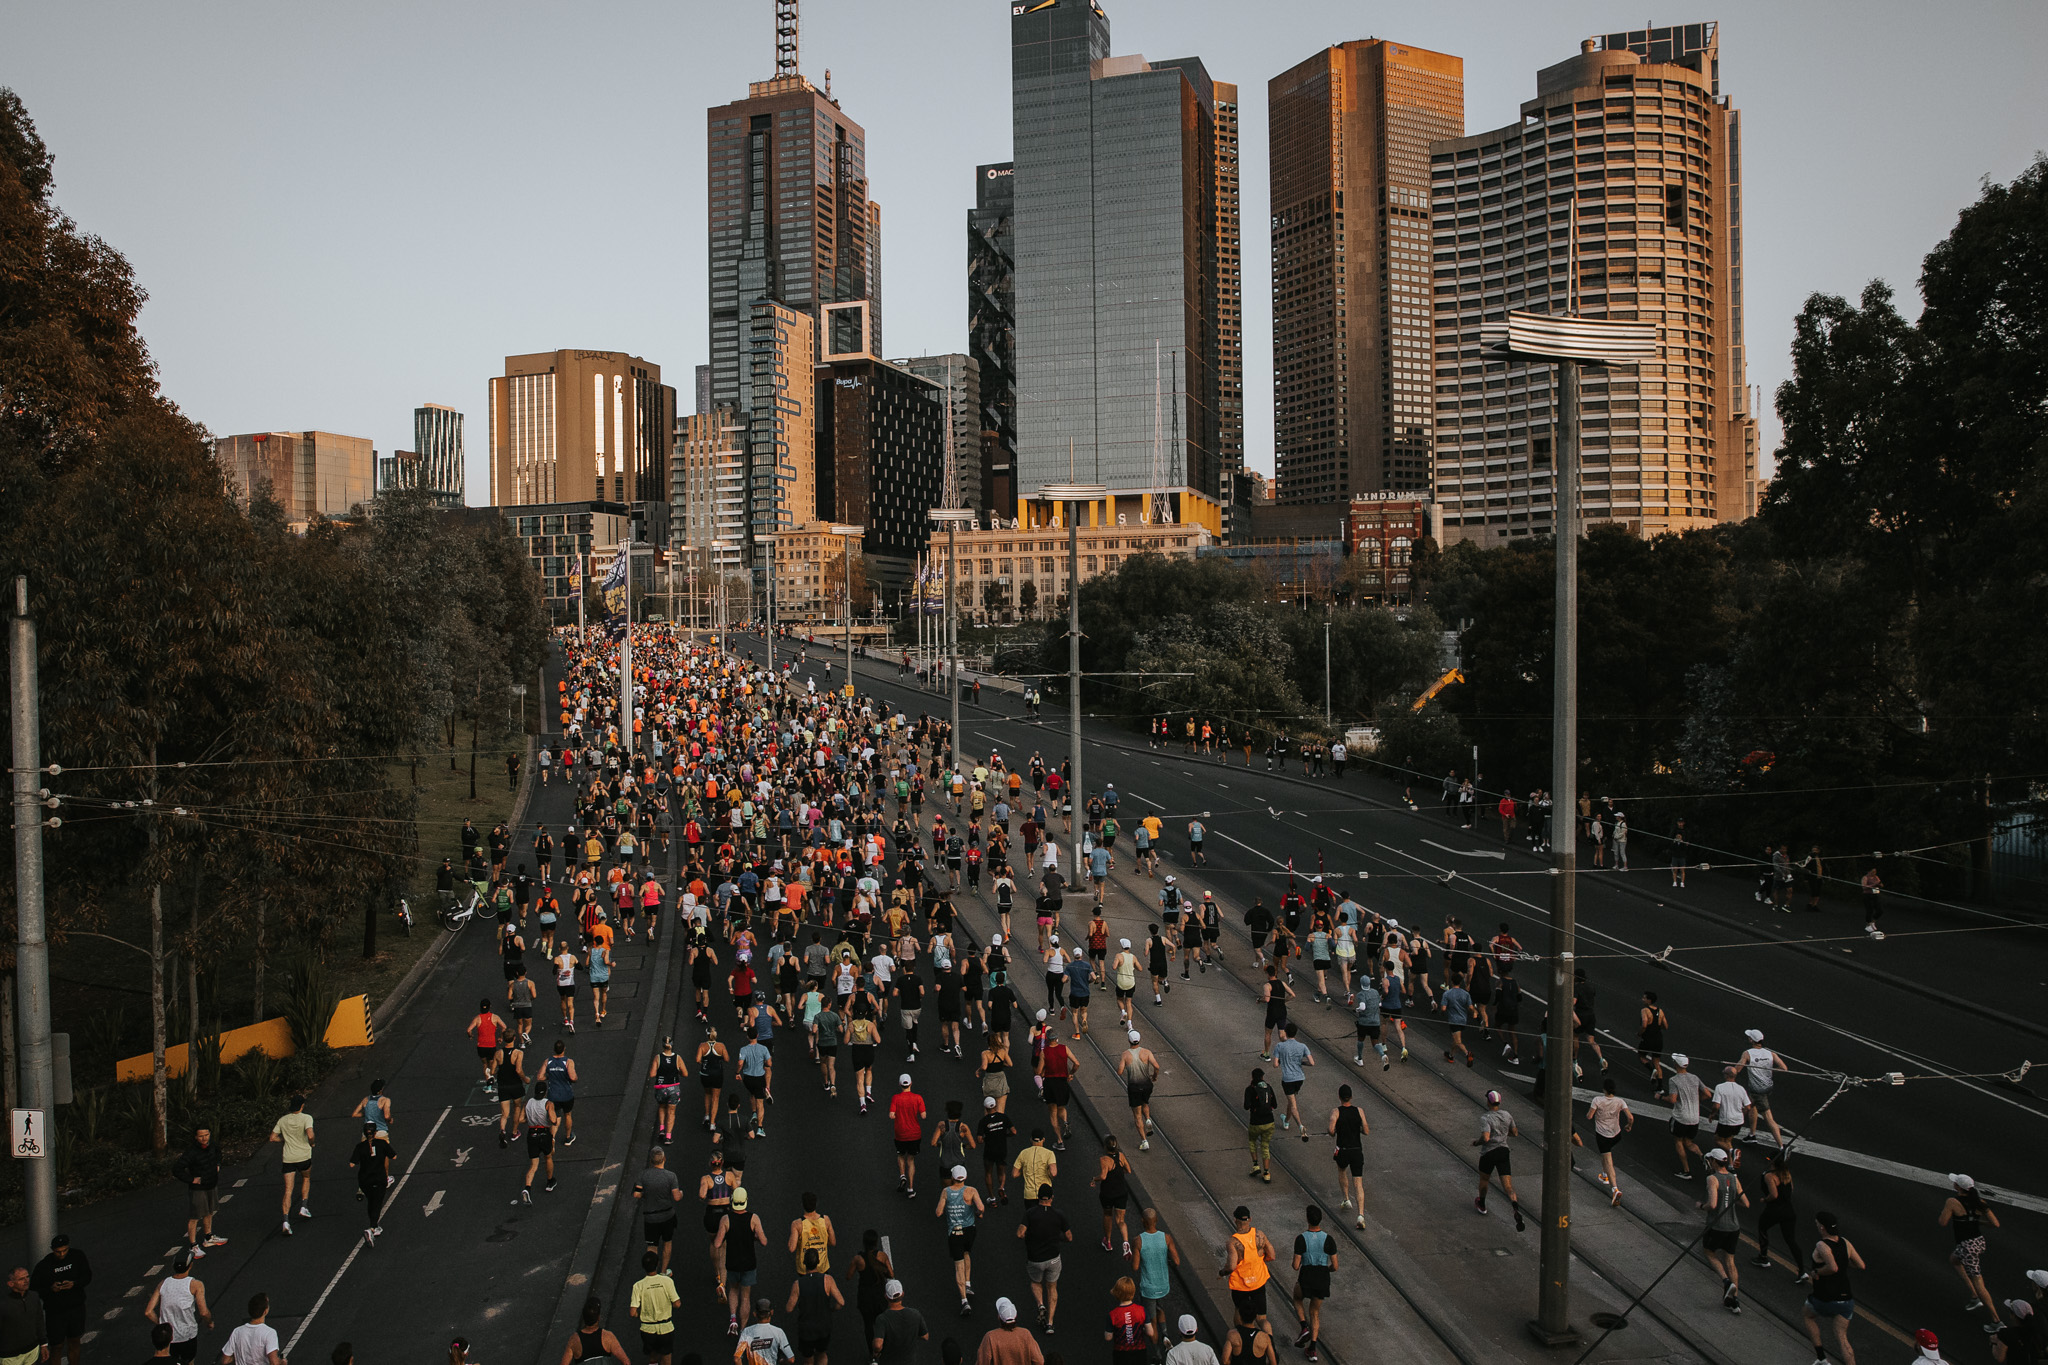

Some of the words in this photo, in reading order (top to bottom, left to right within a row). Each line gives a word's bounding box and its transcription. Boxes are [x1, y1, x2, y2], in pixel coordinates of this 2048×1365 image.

[1013, 5, 1025, 15] EY
[1356, 491, 1415, 501] LINDRUM
[1118, 512, 1172, 524] SUN
